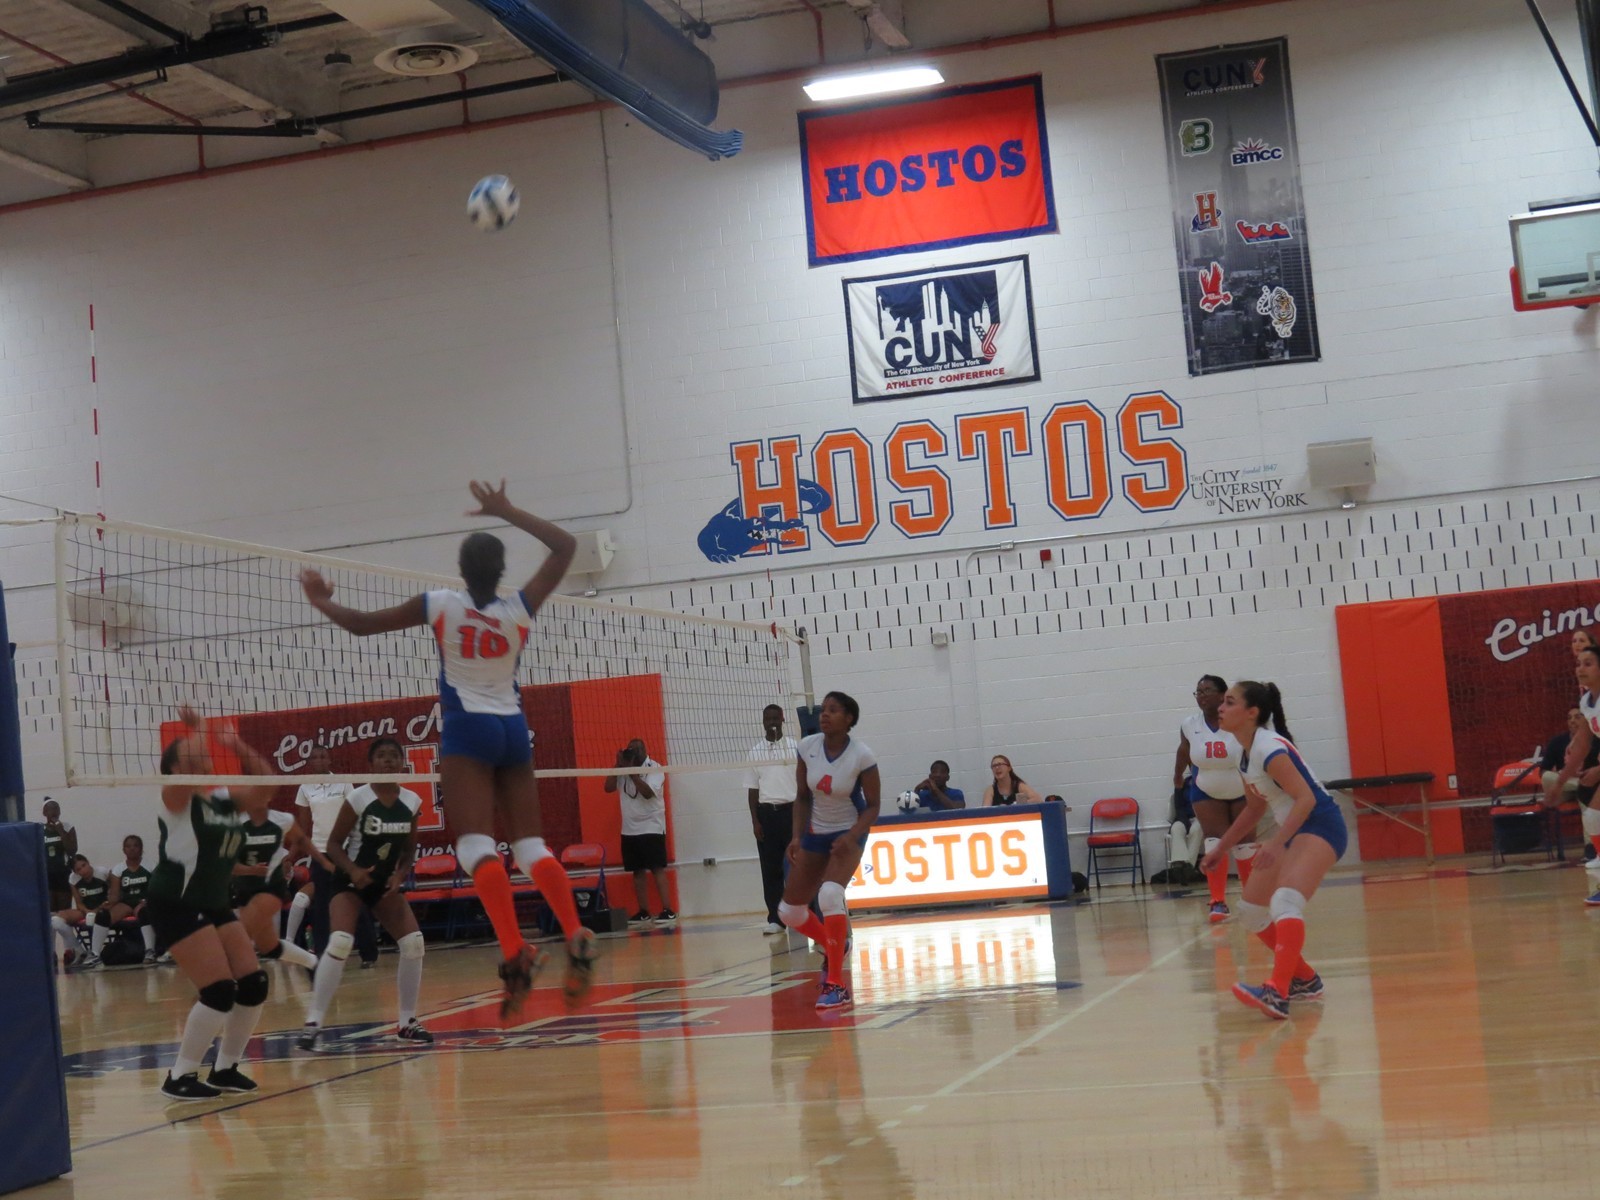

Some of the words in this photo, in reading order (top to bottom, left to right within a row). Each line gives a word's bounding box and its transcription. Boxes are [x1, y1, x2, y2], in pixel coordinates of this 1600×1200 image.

[824, 139, 1026, 203] HOSTOS
[884, 322, 1001, 370] CUNY
[886, 377, 934, 390] ATHLETIC
[939, 367, 1005, 383] CONFERENCE
[899, 367, 912, 375] City
[912, 364, 942, 374] University
[951, 361, 965, 369] New
[730, 390, 1189, 558] HOSTOS
[1202, 469, 1240, 485] CITY
[1190, 479, 1283, 500] UNIVERSITY
[1218, 496, 1261, 515] NEW
[1263, 491, 1309, 509] YORK
[1204, 741, 1228, 759] 18
[816, 774, 833, 796] 4
[850, 829, 1028, 886] OSTOS
